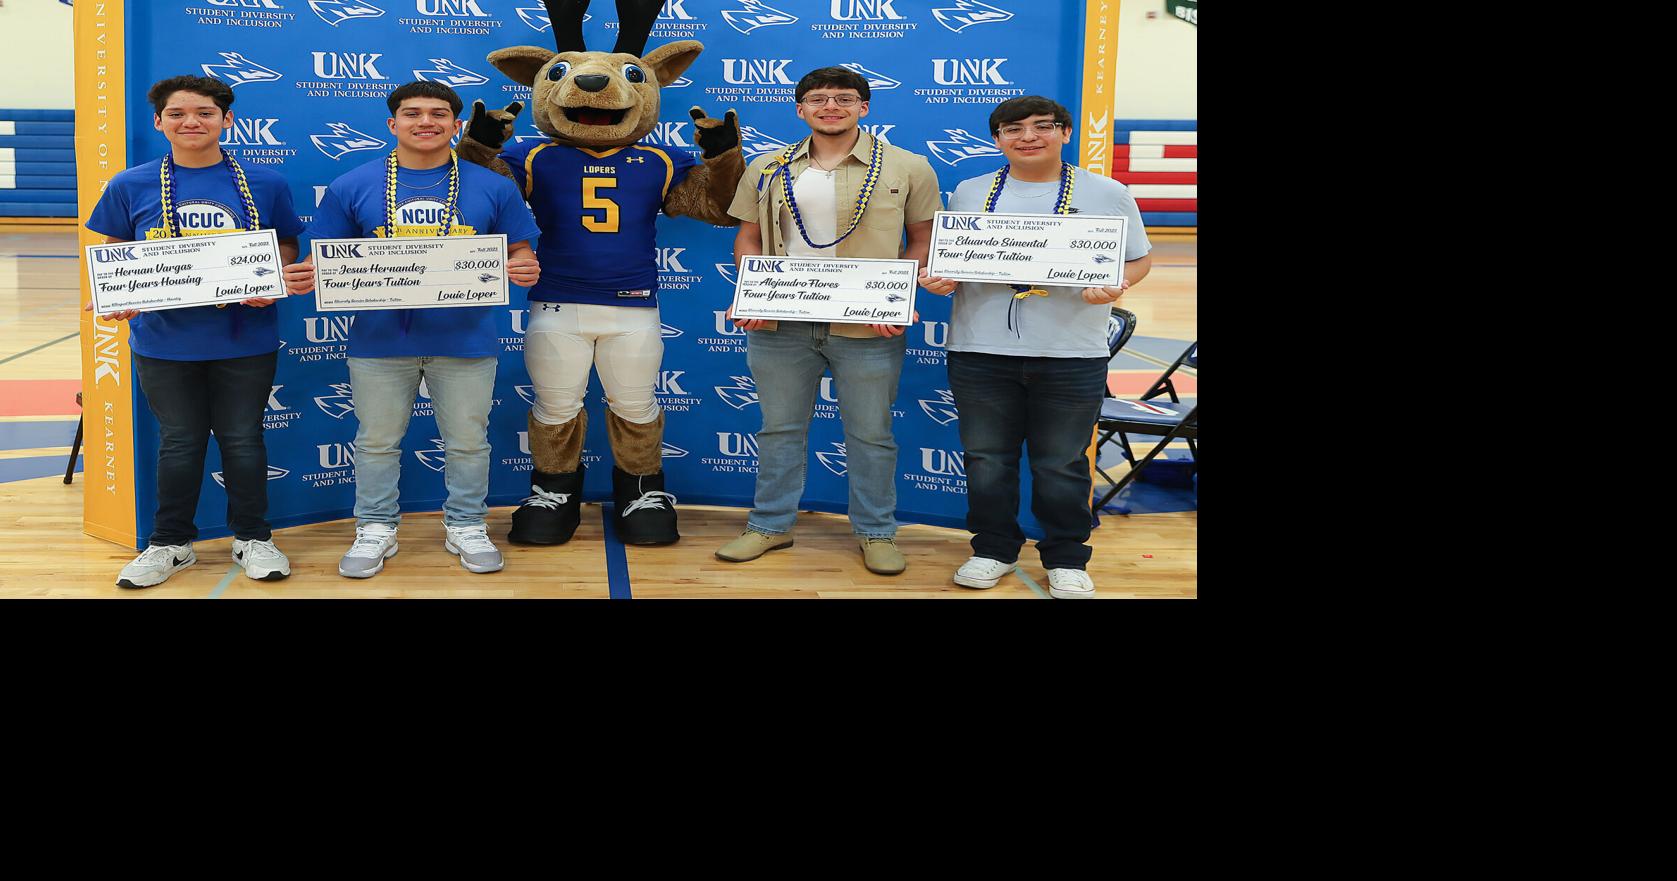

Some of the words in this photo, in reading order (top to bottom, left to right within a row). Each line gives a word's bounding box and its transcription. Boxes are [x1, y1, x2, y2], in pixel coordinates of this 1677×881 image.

[185, 7, 236, 17] STUDENT
[241, 11, 296, 21] DIVERSITY
[829, 0, 902, 21] UNK
[197, 17, 222, 25] AND
[226, 18, 282, 28] INCLUSION
[398, 17, 446, 26] STUDENT
[450, 19, 503, 28] DIVERSITY
[811, 23, 860, 31] STUDENT
[863, 23, 918, 31] DIVERSITY
[410, 26, 432, 34] AND
[436, 27, 490, 35] INCLUSION
[821, 31, 845, 39] AND
[849, 31, 904, 39] INCLUSION
[1095, 2, 1109, 95] KEARNEY
[95, 1, 108, 134] NIVERSITY
[311, 51, 385, 80] UNK
[721, 58, 795, 85] UNK
[931, 58, 1010, 86] UNK
[295, 81, 344, 90] STUDENT
[347, 82, 400, 91] DIVERSITY
[502, 85, 533, 93] STUD
[705, 87, 752, 95] STUDENT
[756, 87, 796, 96] DIVERSI
[307, 90, 330, 98] AND
[333, 90, 387, 98] INCLUSION
[914, 88, 964, 96] STUDENT
[967, 88, 1025, 97] DIVERSITY
[715, 95, 739, 103] AND
[742, 95, 796, 103] INCLUSION
[924, 96, 949, 104] AND
[952, 96, 1011, 104] INCLUSION
[640, 121, 691, 147] NK
[98, 143, 108, 170] OF
[243, 149, 297, 157] DIVERSITY
[583, 165, 616, 175] LOPERS
[581, 176, 620, 233] 5
[178, 212, 225, 229] NCUC
[941, 215, 982, 231] UNK
[152, 229, 167, 239] 20
[141, 244, 176, 253] STUDENT
[178, 241, 216, 250] DIVERSITY
[955, 235, 999, 247] Eduardo
[1000, 237, 1048, 249] Simental
[94, 246, 139, 264] UNK
[161, 247, 201, 256] INCLUSION
[319, 244, 364, 259] UNK
[937, 248, 963, 259] Four
[963, 249, 996, 262] Years
[997, 250, 1034, 262] Tuition
[115, 267, 154, 277] Hernan
[155, 263, 193, 274] Vargas
[339, 265, 369, 275] Jesus
[369, 263, 427, 275] Hernandez
[747, 259, 785, 273] UNK
[1047, 268, 1076, 280] Louie
[1076, 268, 1111, 281] Loper
[99, 281, 127, 292] Four
[128, 279, 159, 292] Years
[160, 275, 203, 287] Housing
[322, 278, 351, 289] Four
[351, 277, 383, 290] Years
[383, 276, 422, 287] Tuition
[759, 277, 808, 290] Alejandro
[808, 278, 840, 289] Flores
[215, 285, 243, 298] Louie
[244, 283, 275, 295] Loper
[437, 291, 465, 302] Louie
[466, 290, 498, 301] Loper
[742, 289, 767, 299] Four
[767, 290, 796, 302] Years
[797, 291, 831, 302] Tuition
[843, 306, 871, 318] Louie
[871, 307, 902, 319] Loper
[303, 315, 355, 343] UN
[697, 337, 744, 346] STUDENT
[288, 345, 335, 356] STUDENT
[905, 348, 947, 357] STUDEN
[299, 354, 321, 362] AND
[916, 357, 940, 366] AND
[658, 397, 702, 405] IVERSITY
[263, 412, 302, 422] ERSITY
[411, 409, 434, 417] AND
[813, 411, 835, 419] AND
[104, 400, 116, 496] KEARNEY
[716, 432, 759, 458] UN
[316, 442, 355, 469] UN
[502, 457, 533, 465] STUDE
[701, 457, 748, 466] STUDENT
[512, 464, 534, 472] AND
[919, 448, 967, 477] UN
[301, 469, 348, 481] STUDENT
[712, 465, 734, 473] AND
[312, 478, 335, 488] AND
[903, 473, 952, 485] STUDENT
[914, 482, 938, 491] AND
